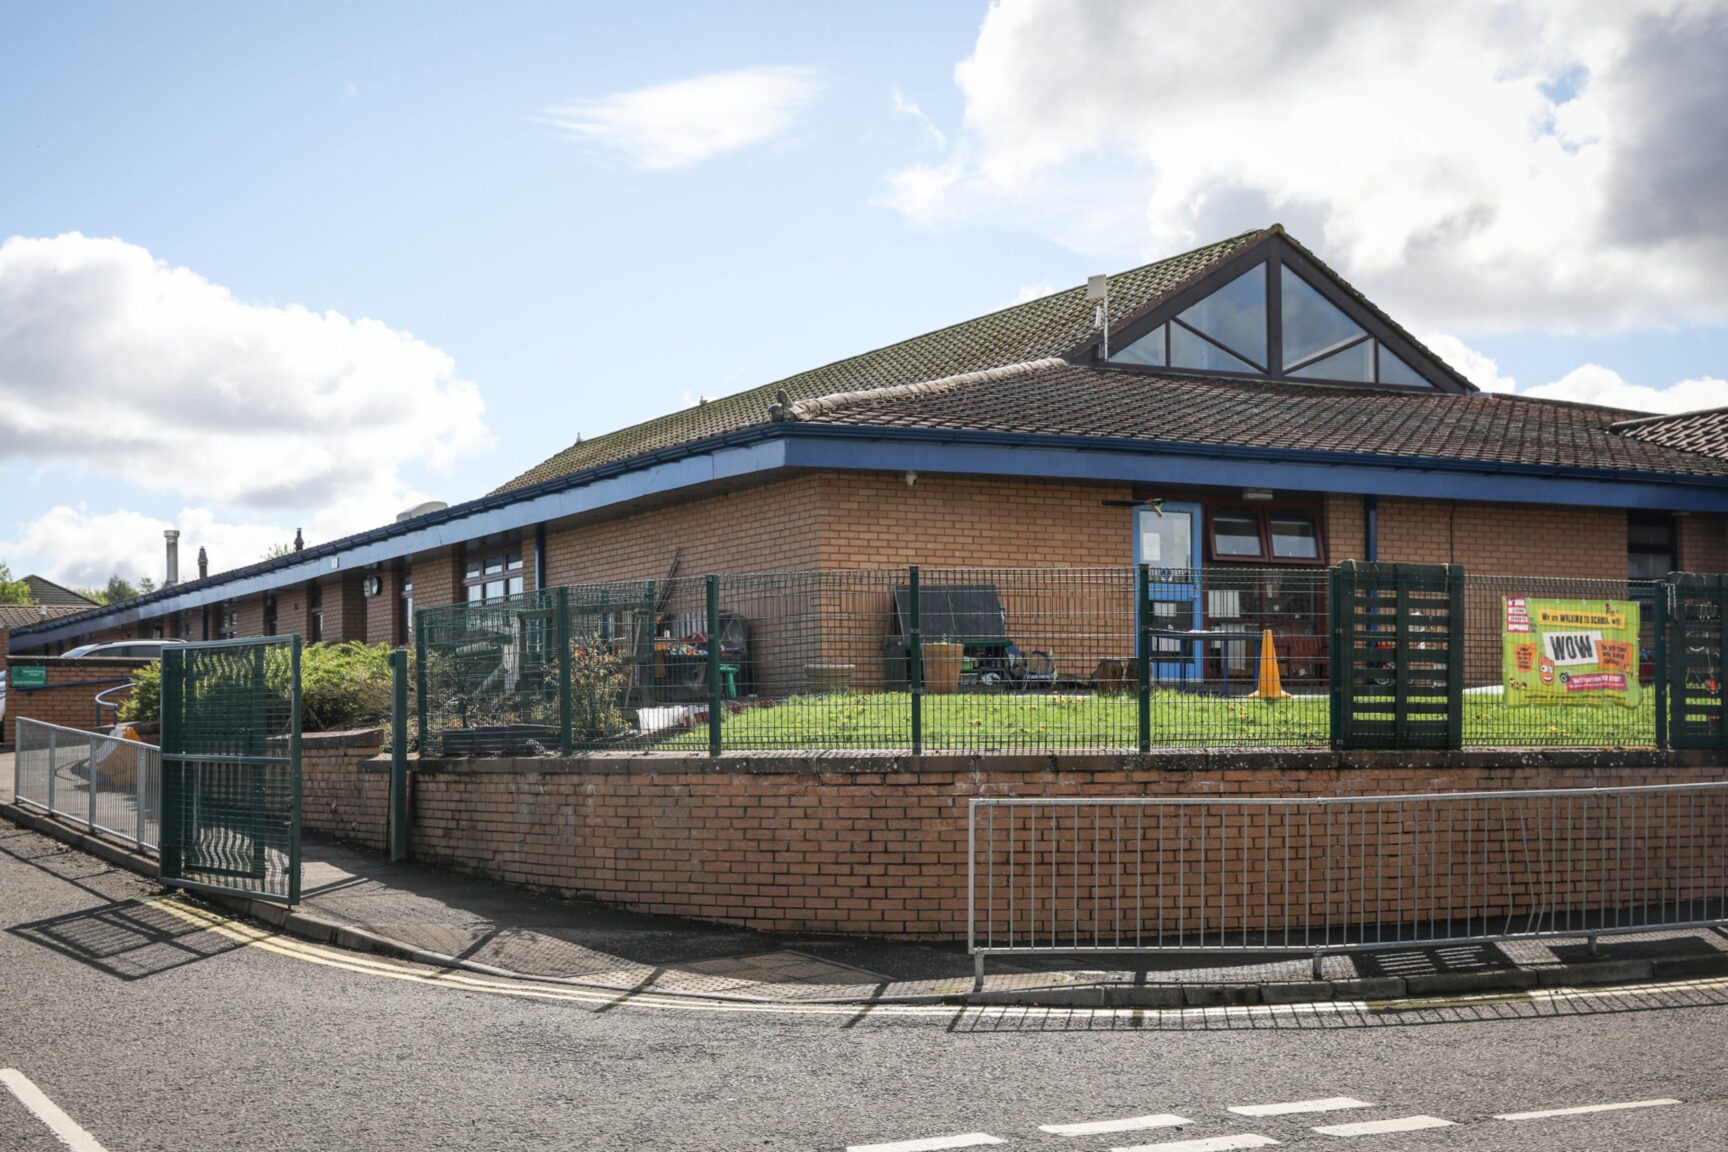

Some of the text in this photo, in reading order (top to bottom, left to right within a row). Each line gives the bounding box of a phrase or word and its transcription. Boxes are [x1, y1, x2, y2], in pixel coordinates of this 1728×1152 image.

[1560, 614, 1583, 624] WALKING
[1590, 616, 1610, 625] SCHOOL
[1549, 635, 1593, 661] WOW
